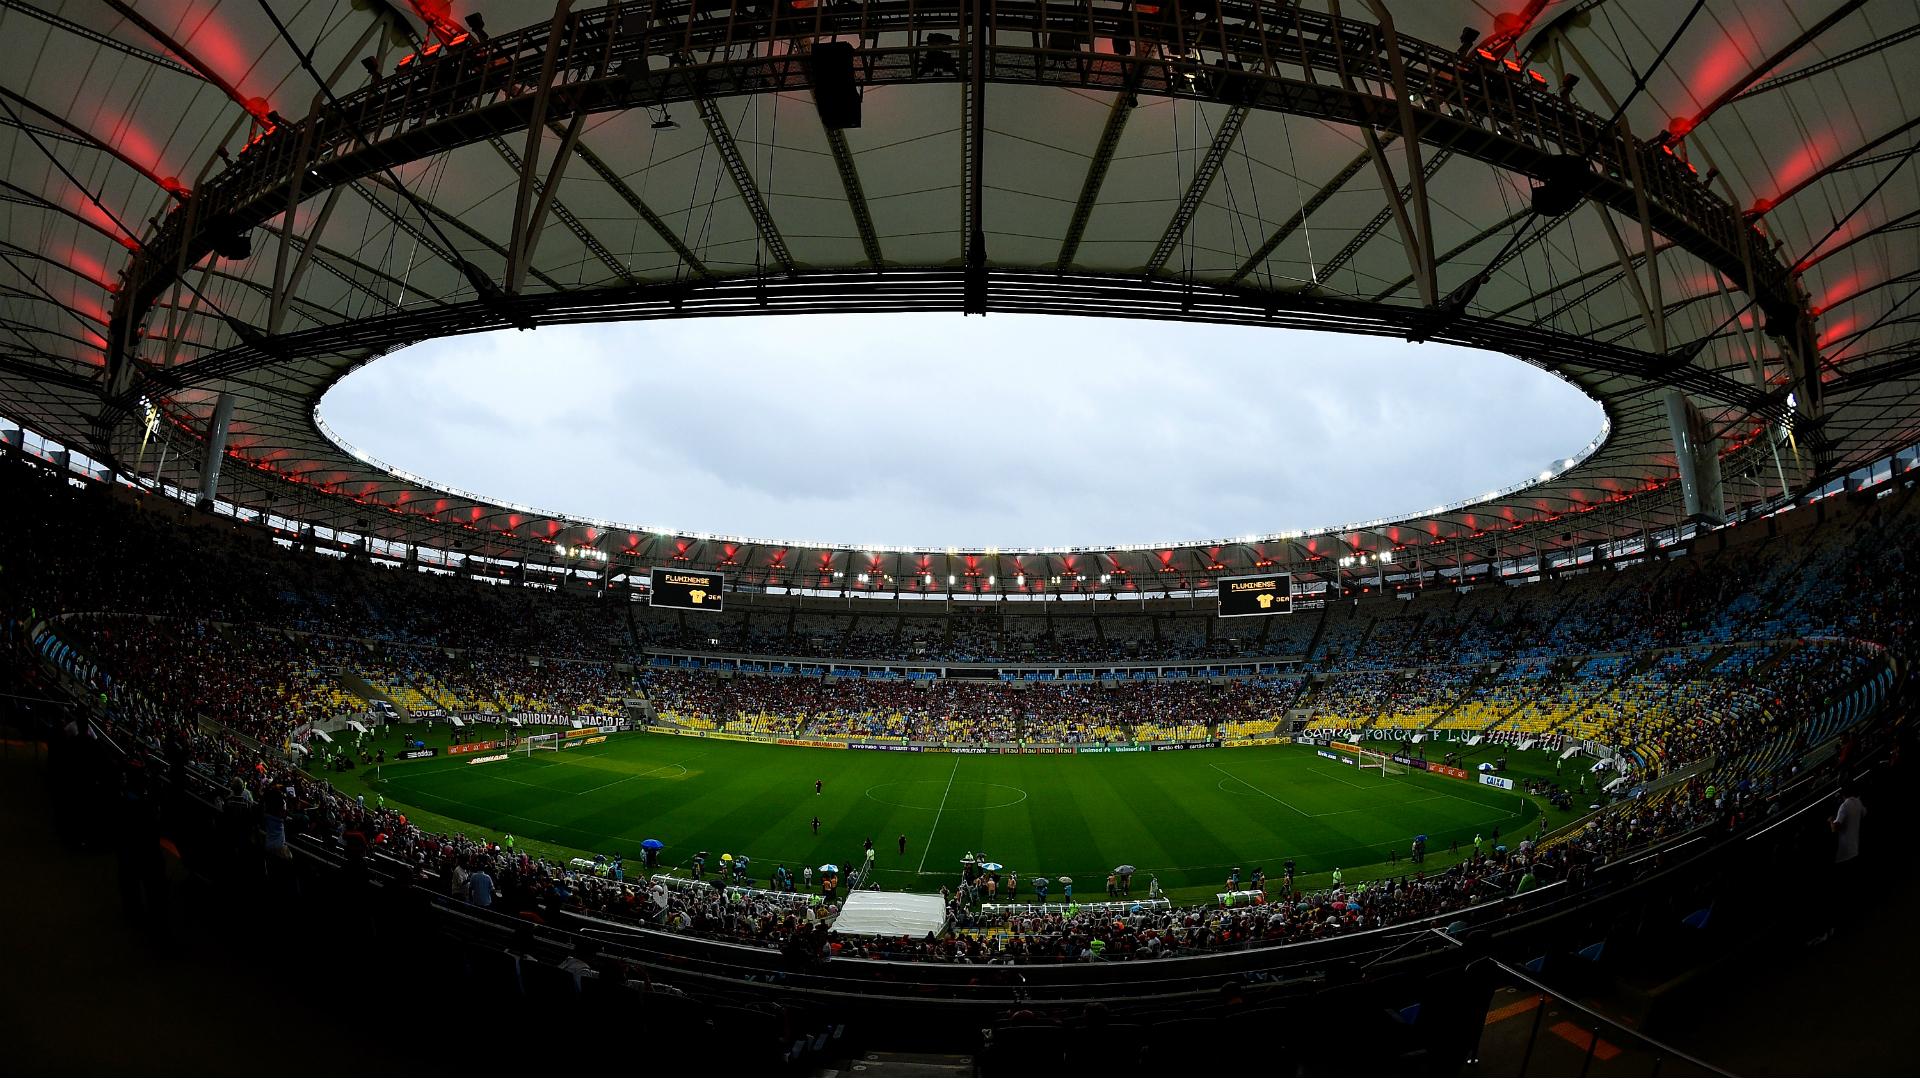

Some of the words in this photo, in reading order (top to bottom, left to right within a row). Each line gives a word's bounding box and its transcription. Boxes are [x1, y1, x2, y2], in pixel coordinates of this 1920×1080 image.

[665, 574, 710, 585] FLUMINENSE
[1231, 580, 1277, 590] FLUMINENSE
[517, 713, 570, 725] URUBUZADA
[1486, 776, 1505, 788] CAIXA
